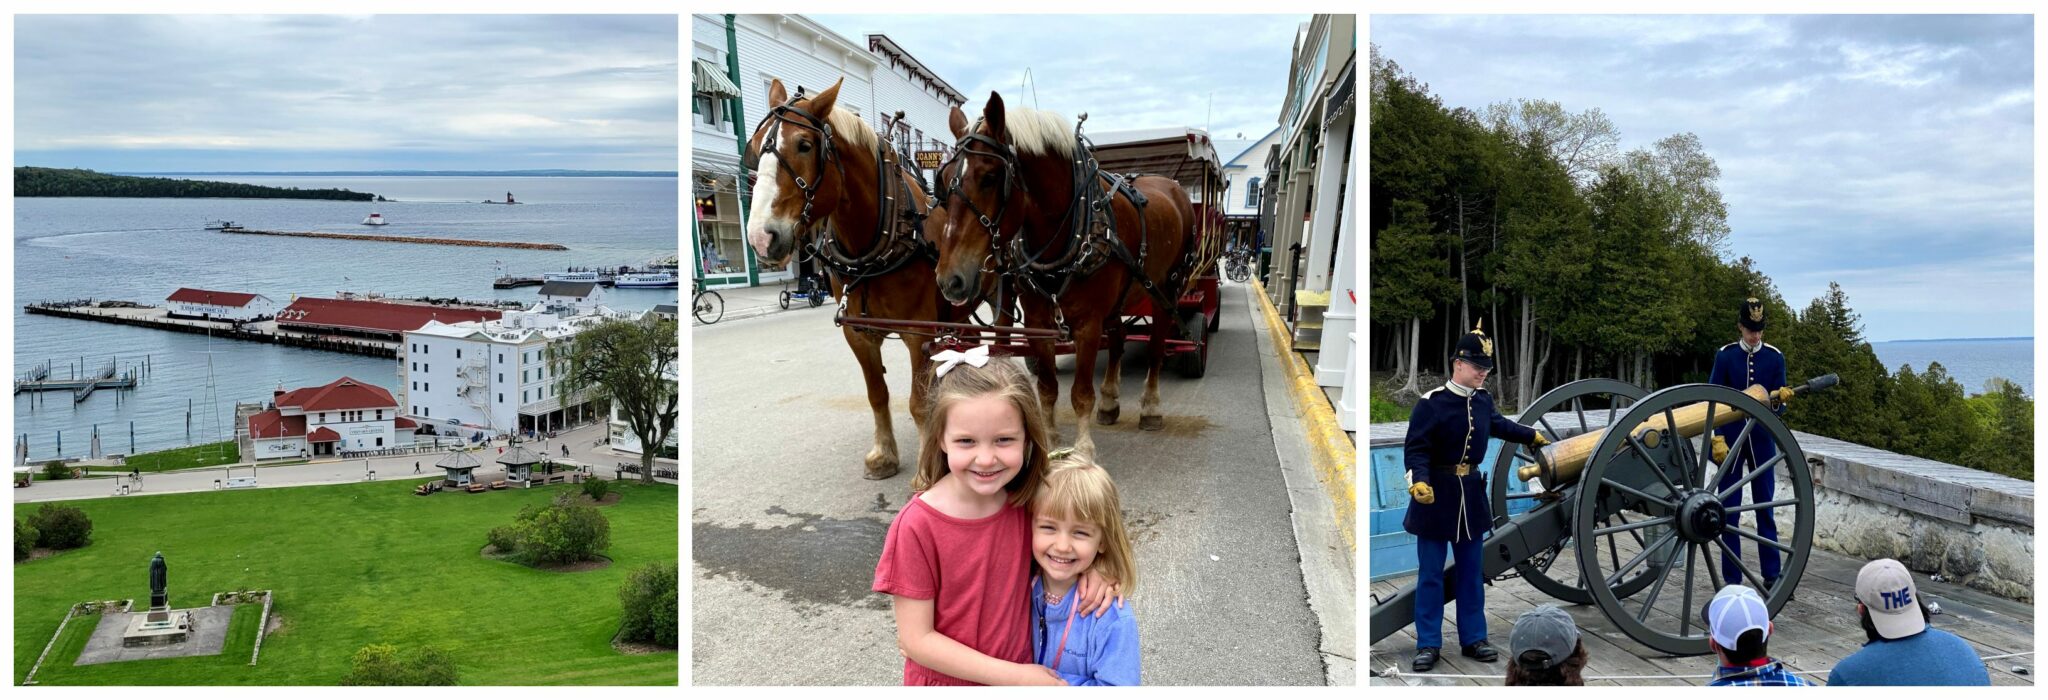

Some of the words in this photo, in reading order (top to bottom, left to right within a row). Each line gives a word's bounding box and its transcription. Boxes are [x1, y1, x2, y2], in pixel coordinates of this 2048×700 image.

[916, 152, 943, 161] JOANN'S
[921, 160, 939, 168] FUDGE
[1880, 586, 1912, 610] THE
